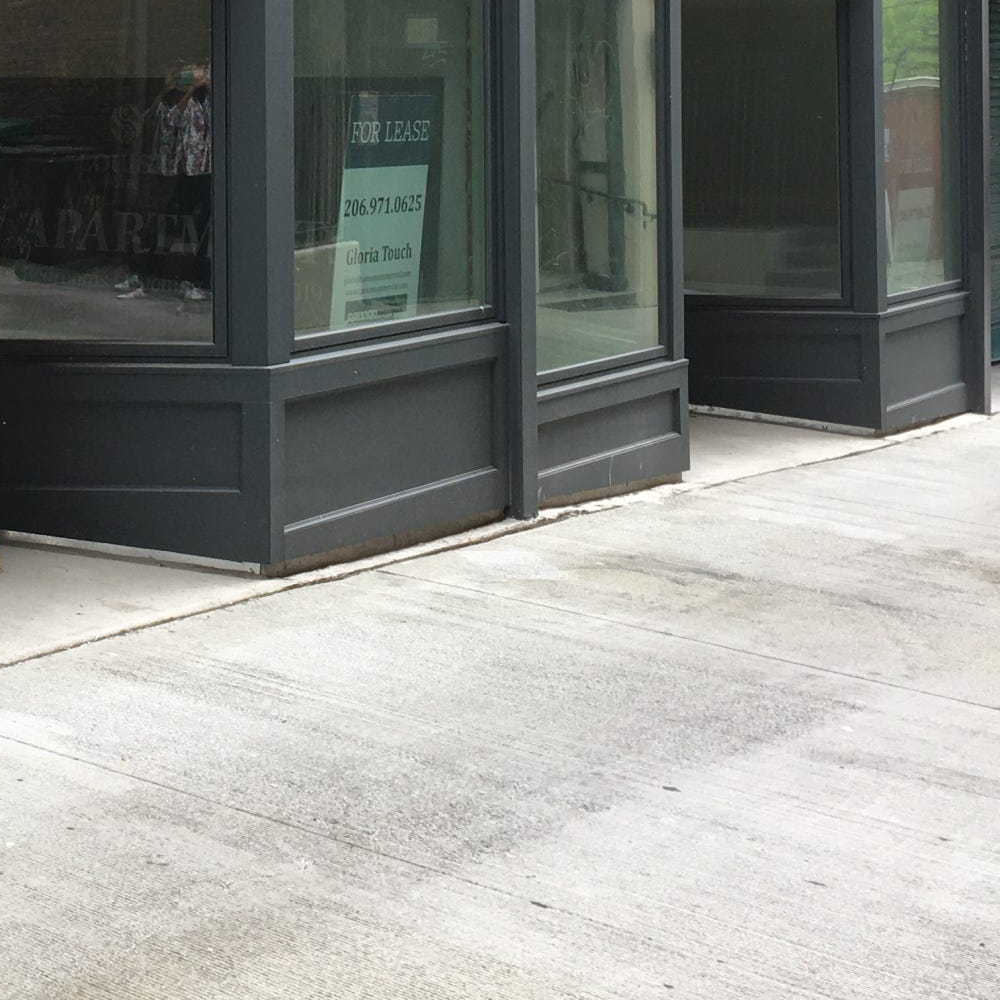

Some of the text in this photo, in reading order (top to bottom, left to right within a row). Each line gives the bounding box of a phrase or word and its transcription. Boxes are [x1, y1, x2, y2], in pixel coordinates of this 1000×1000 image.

[350, 120, 430, 144] FOR LEASE
[343, 194, 422, 217] 206.971.0625
[346, 242, 412, 266] Gloria Touch
